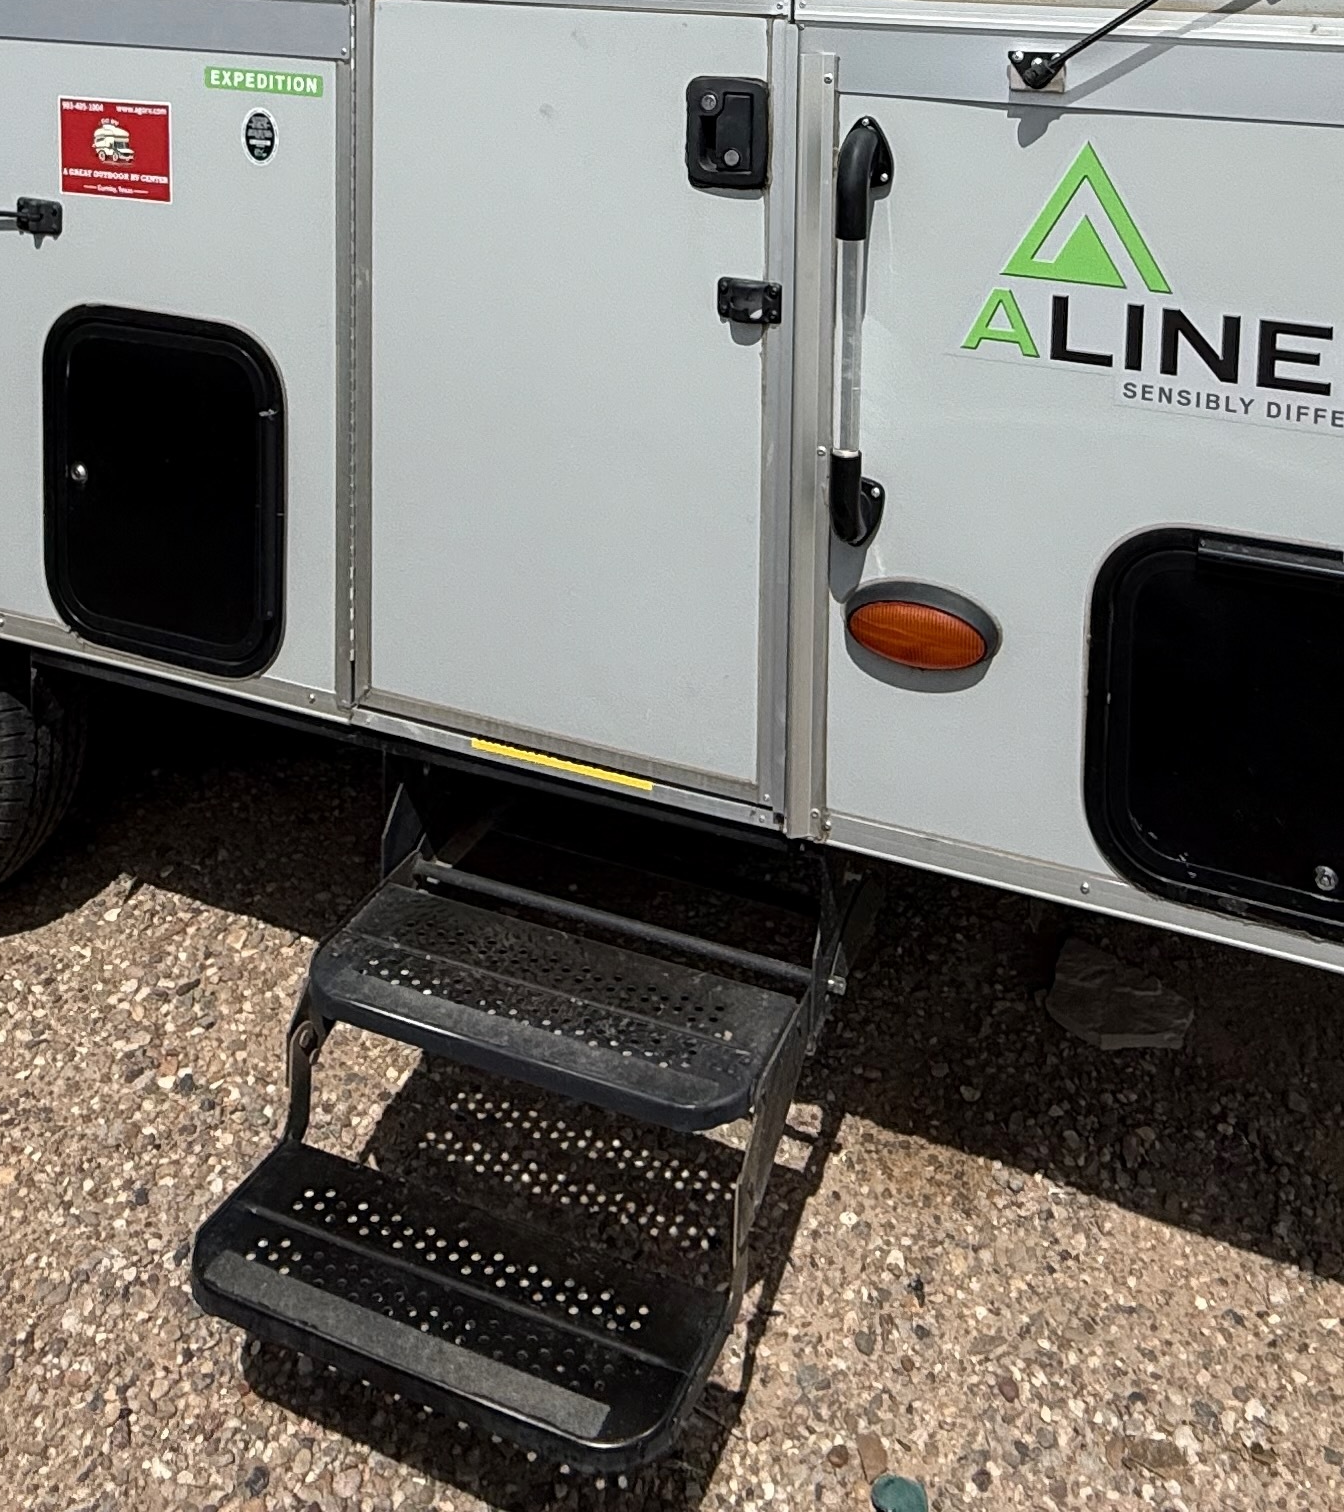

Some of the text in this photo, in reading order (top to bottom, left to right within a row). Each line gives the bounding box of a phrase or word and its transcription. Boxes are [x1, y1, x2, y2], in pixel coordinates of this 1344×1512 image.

[210, 69, 318, 94] EXPEDITION
[62, 167, 68, 176] A
[69, 169, 92, 178] GREAT
[93, 171, 129, 181] OUTDOOR
[140, 175, 168, 184] CENTER
[1122, 382, 1254, 416] SENSIBLY
